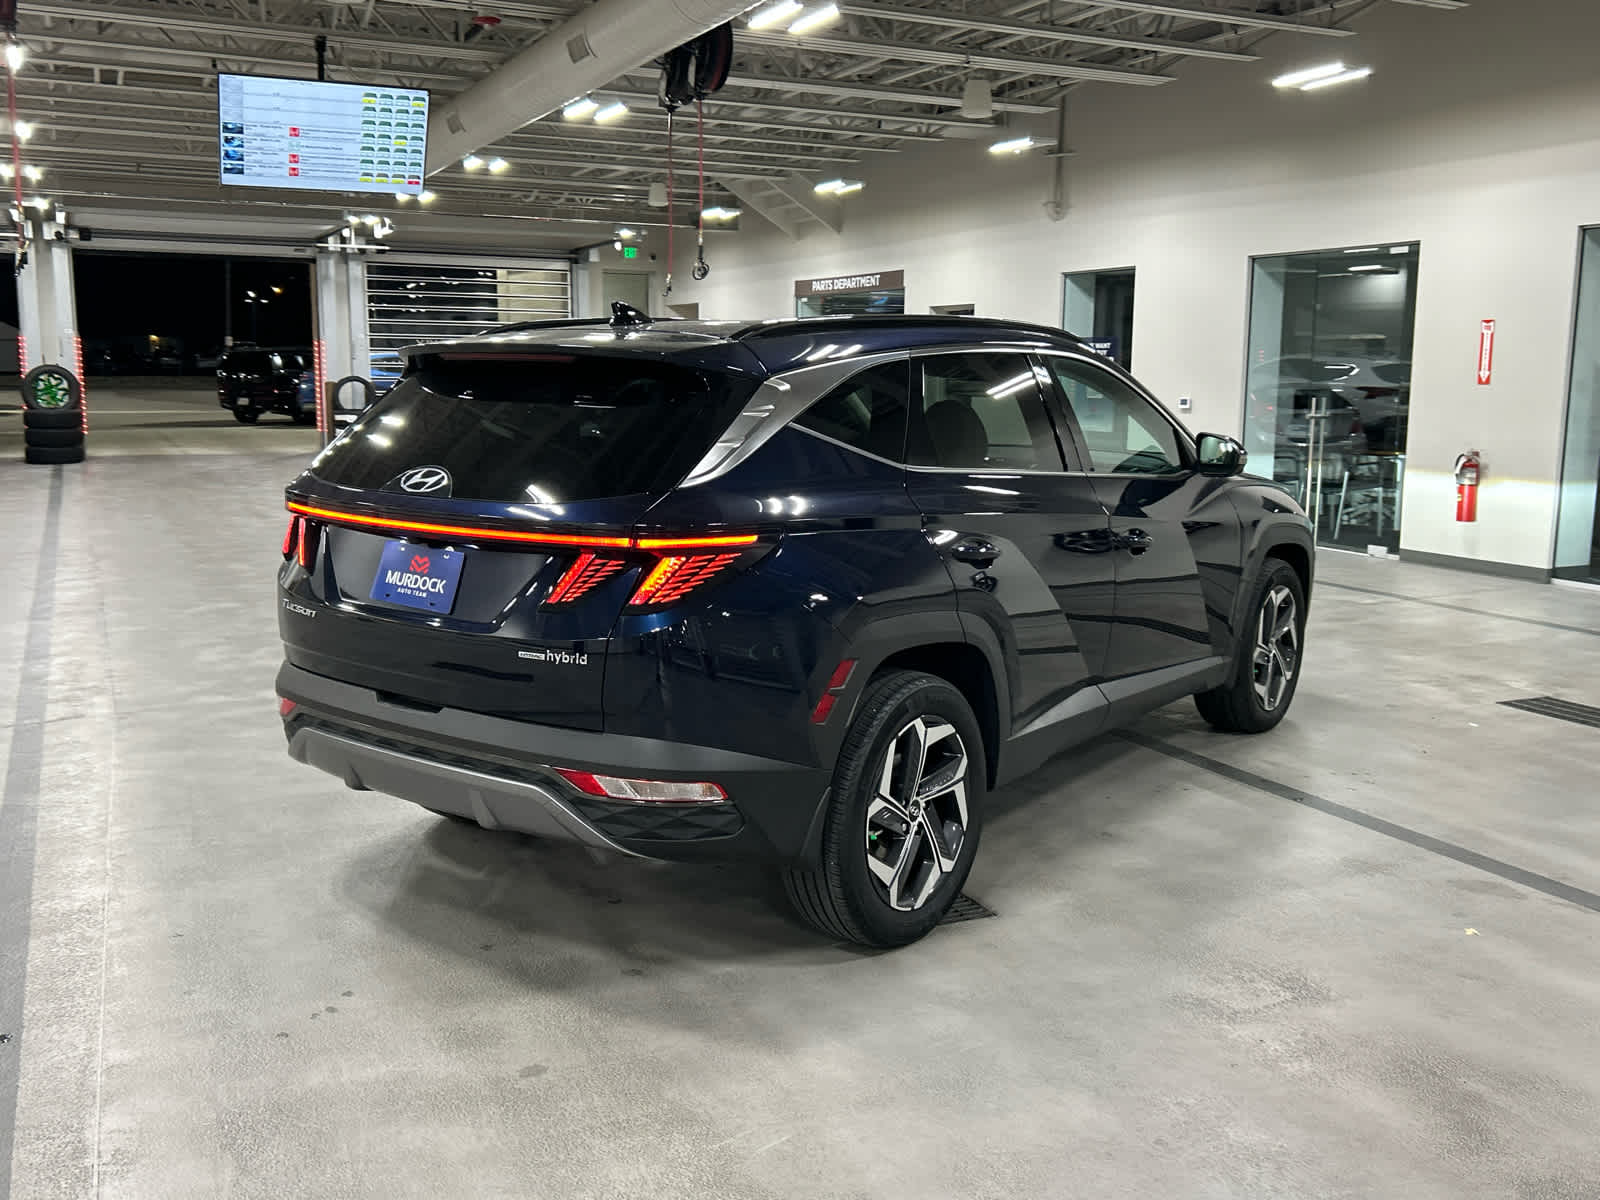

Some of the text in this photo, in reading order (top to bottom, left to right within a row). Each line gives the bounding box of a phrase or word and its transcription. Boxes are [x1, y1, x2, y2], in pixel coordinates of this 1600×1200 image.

[811, 274, 881, 292] PARTS DEPARTMENT
[385, 569, 447, 594] MURDOCK
[396, 587, 428, 598] AUTO TEAM
[546, 649, 588, 665] hybrid
